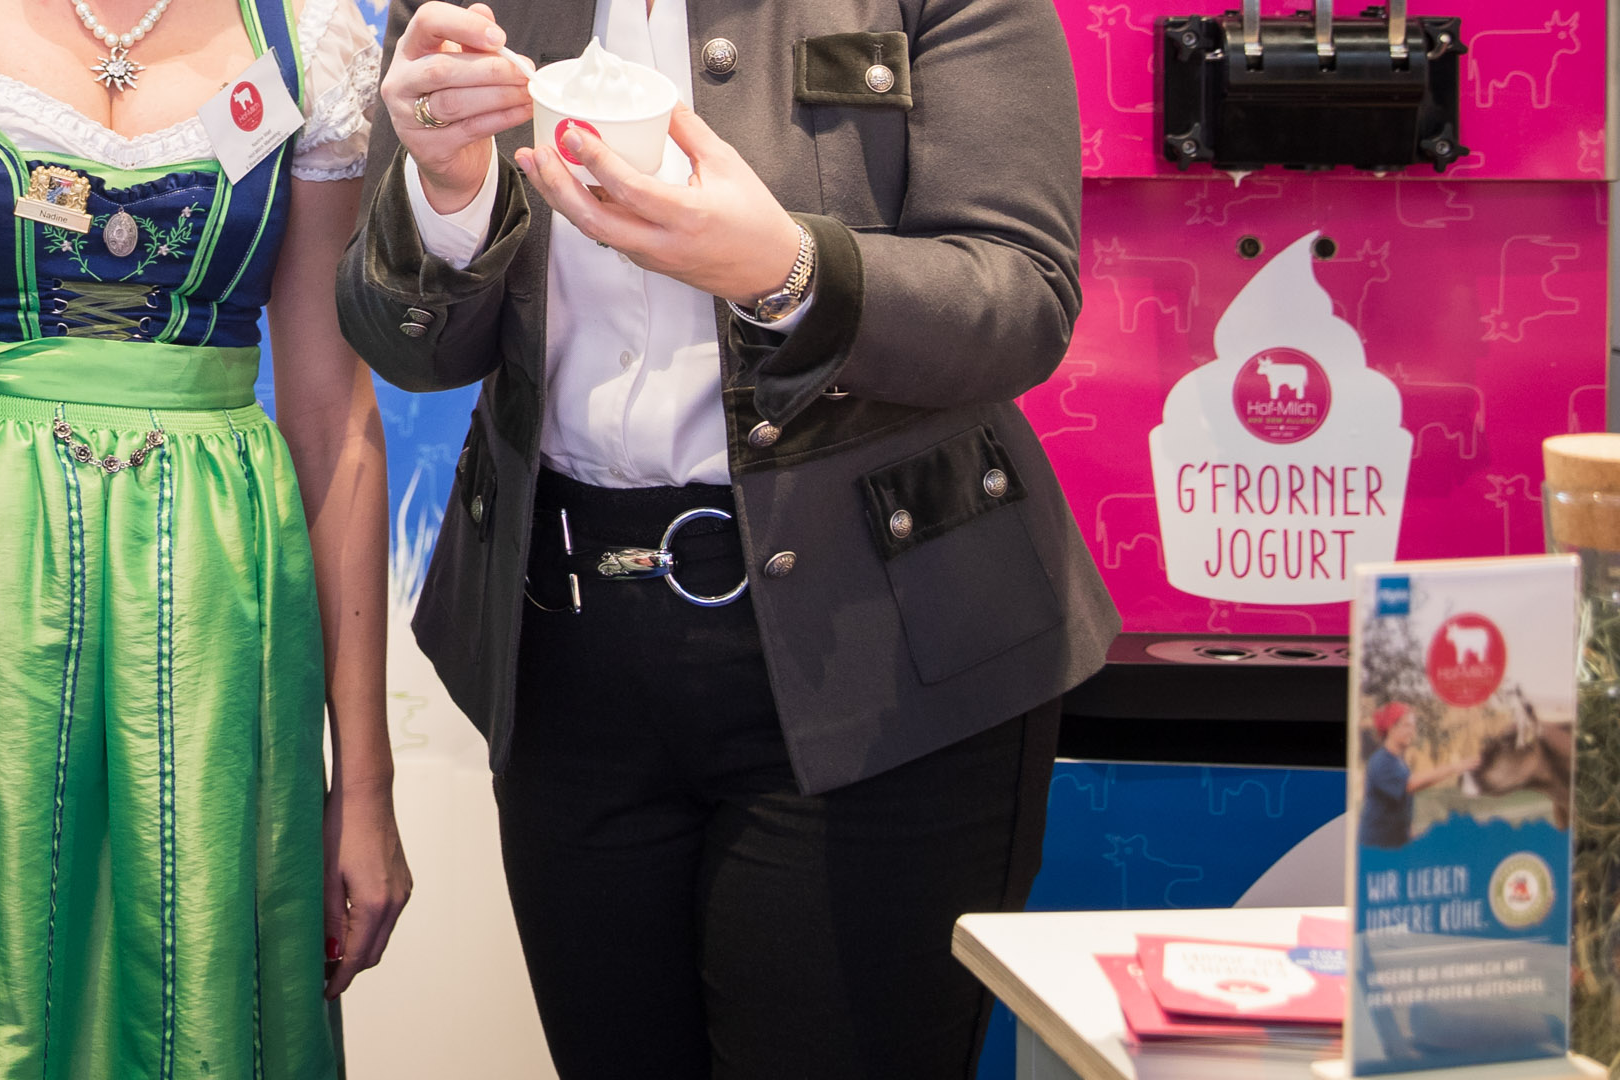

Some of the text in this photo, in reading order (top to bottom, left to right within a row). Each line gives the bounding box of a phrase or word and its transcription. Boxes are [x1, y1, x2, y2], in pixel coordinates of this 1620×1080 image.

[39, 209, 69, 224] Nadine
[1246, 400, 1319, 417] Hof-Milch
[1204, 527, 1356, 580] JOGURT
[1366, 870, 1400, 903] WIR
[1406, 865, 1469, 899] LIEBEN
